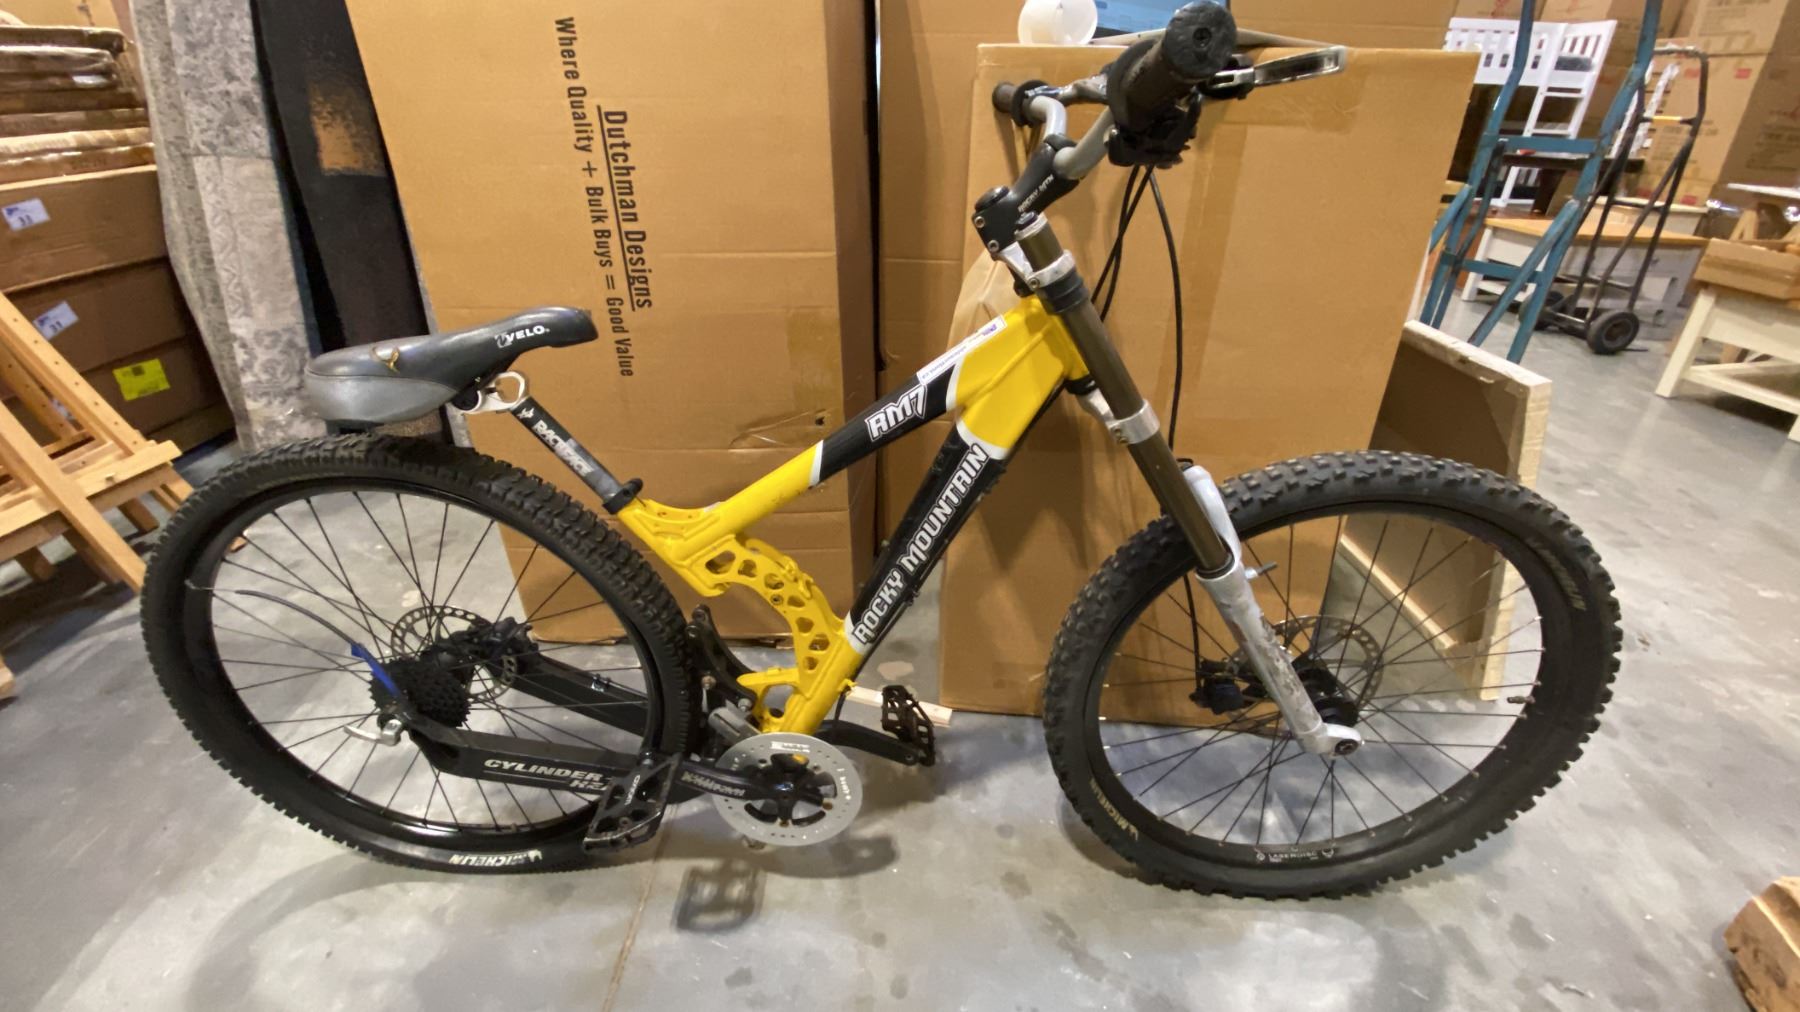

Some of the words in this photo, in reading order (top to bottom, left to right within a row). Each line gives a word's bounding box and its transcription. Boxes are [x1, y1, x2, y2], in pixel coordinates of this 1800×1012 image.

[555, 17, 580, 80] Where
[567, 86, 593, 153] Quality
[585, 186, 605, 224] Bulk
[603, 110, 638, 223] Dutchman
[624, 229, 653, 309] Designs
[593, 228, 613, 268] Buys
[506, 325, 545, 341] VELO
[606, 296, 624, 333] Good
[614, 337, 633, 378] Value
[865, 384, 927, 441] RM7
[852, 568, 905, 646] ROCKY
[899, 442, 989, 574] MOUNTAIN
[484, 759, 604, 782] CYLINDER
